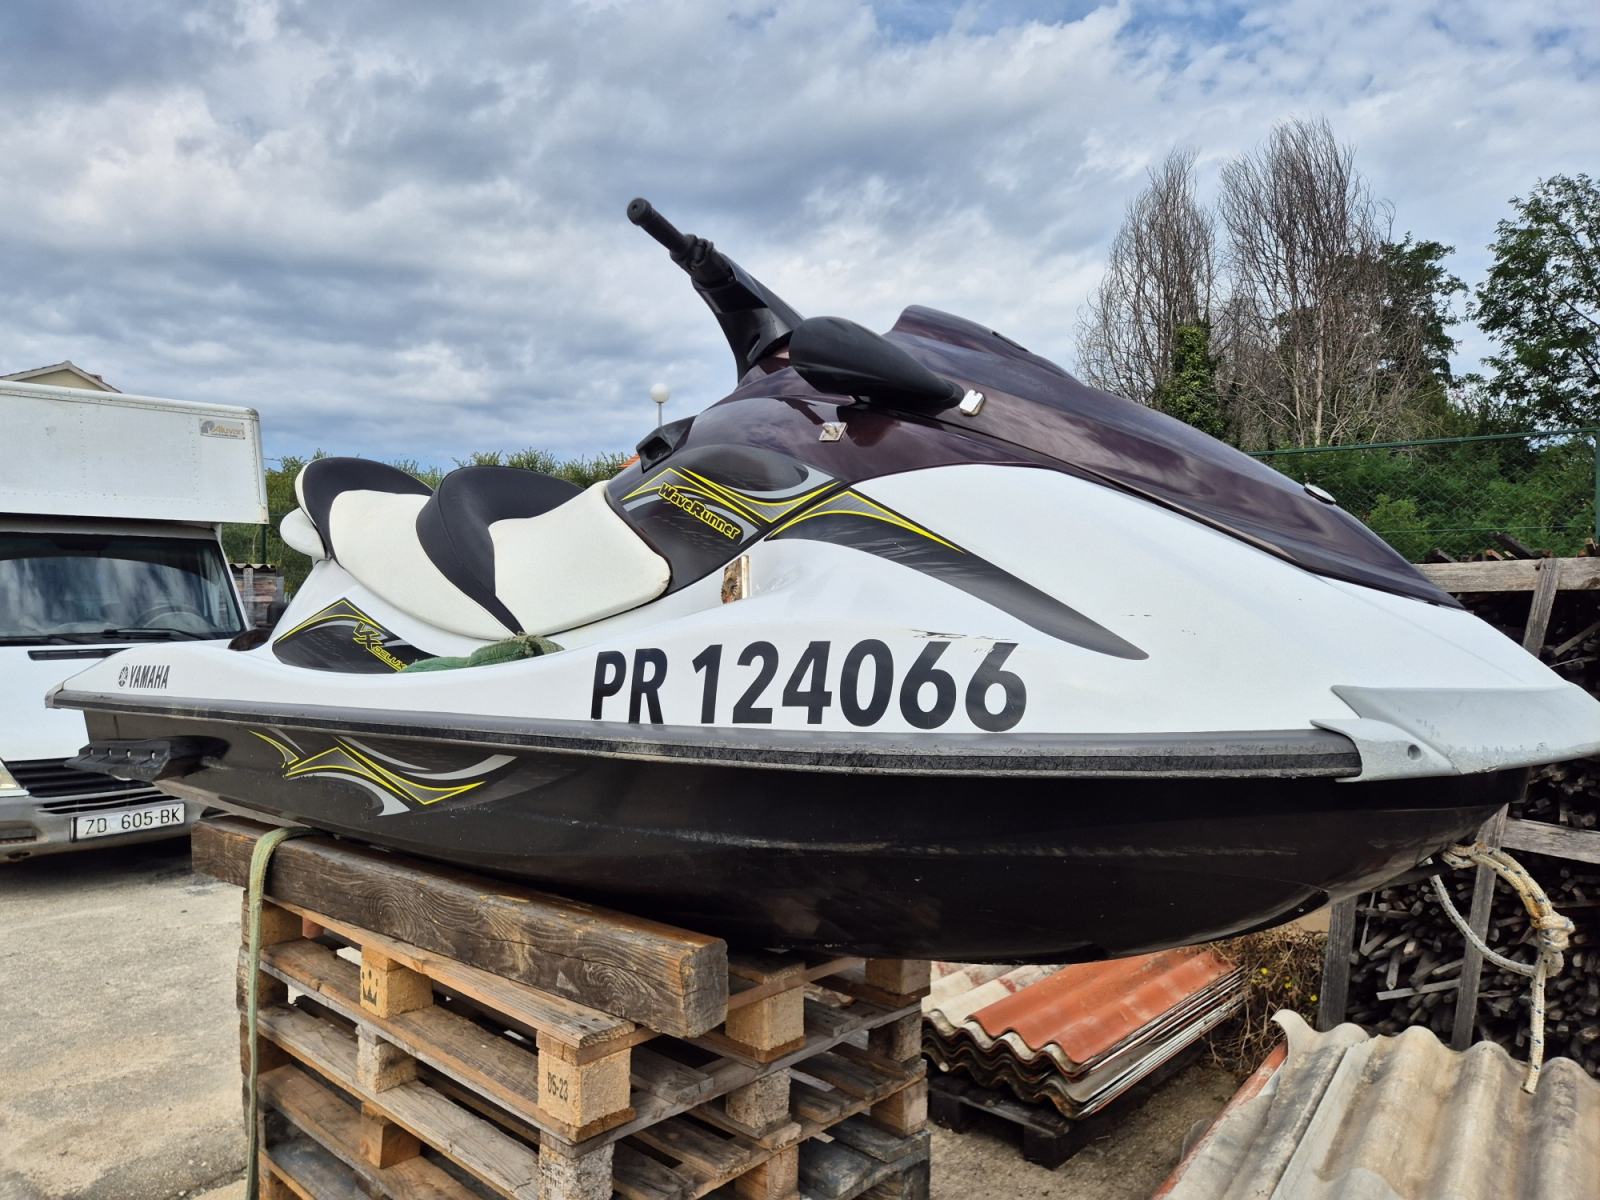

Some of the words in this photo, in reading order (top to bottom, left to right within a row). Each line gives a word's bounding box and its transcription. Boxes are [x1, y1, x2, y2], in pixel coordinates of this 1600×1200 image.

[657, 481, 741, 540] WaveRunner
[353, 621, 383, 650] VX
[129, 665, 170, 688] YAMAHA
[590, 648, 668, 724] PR
[692, 638, 1027, 732] 124066
[86, 817, 107, 835] ZD
[121, 807, 180, 830] 605-BK
